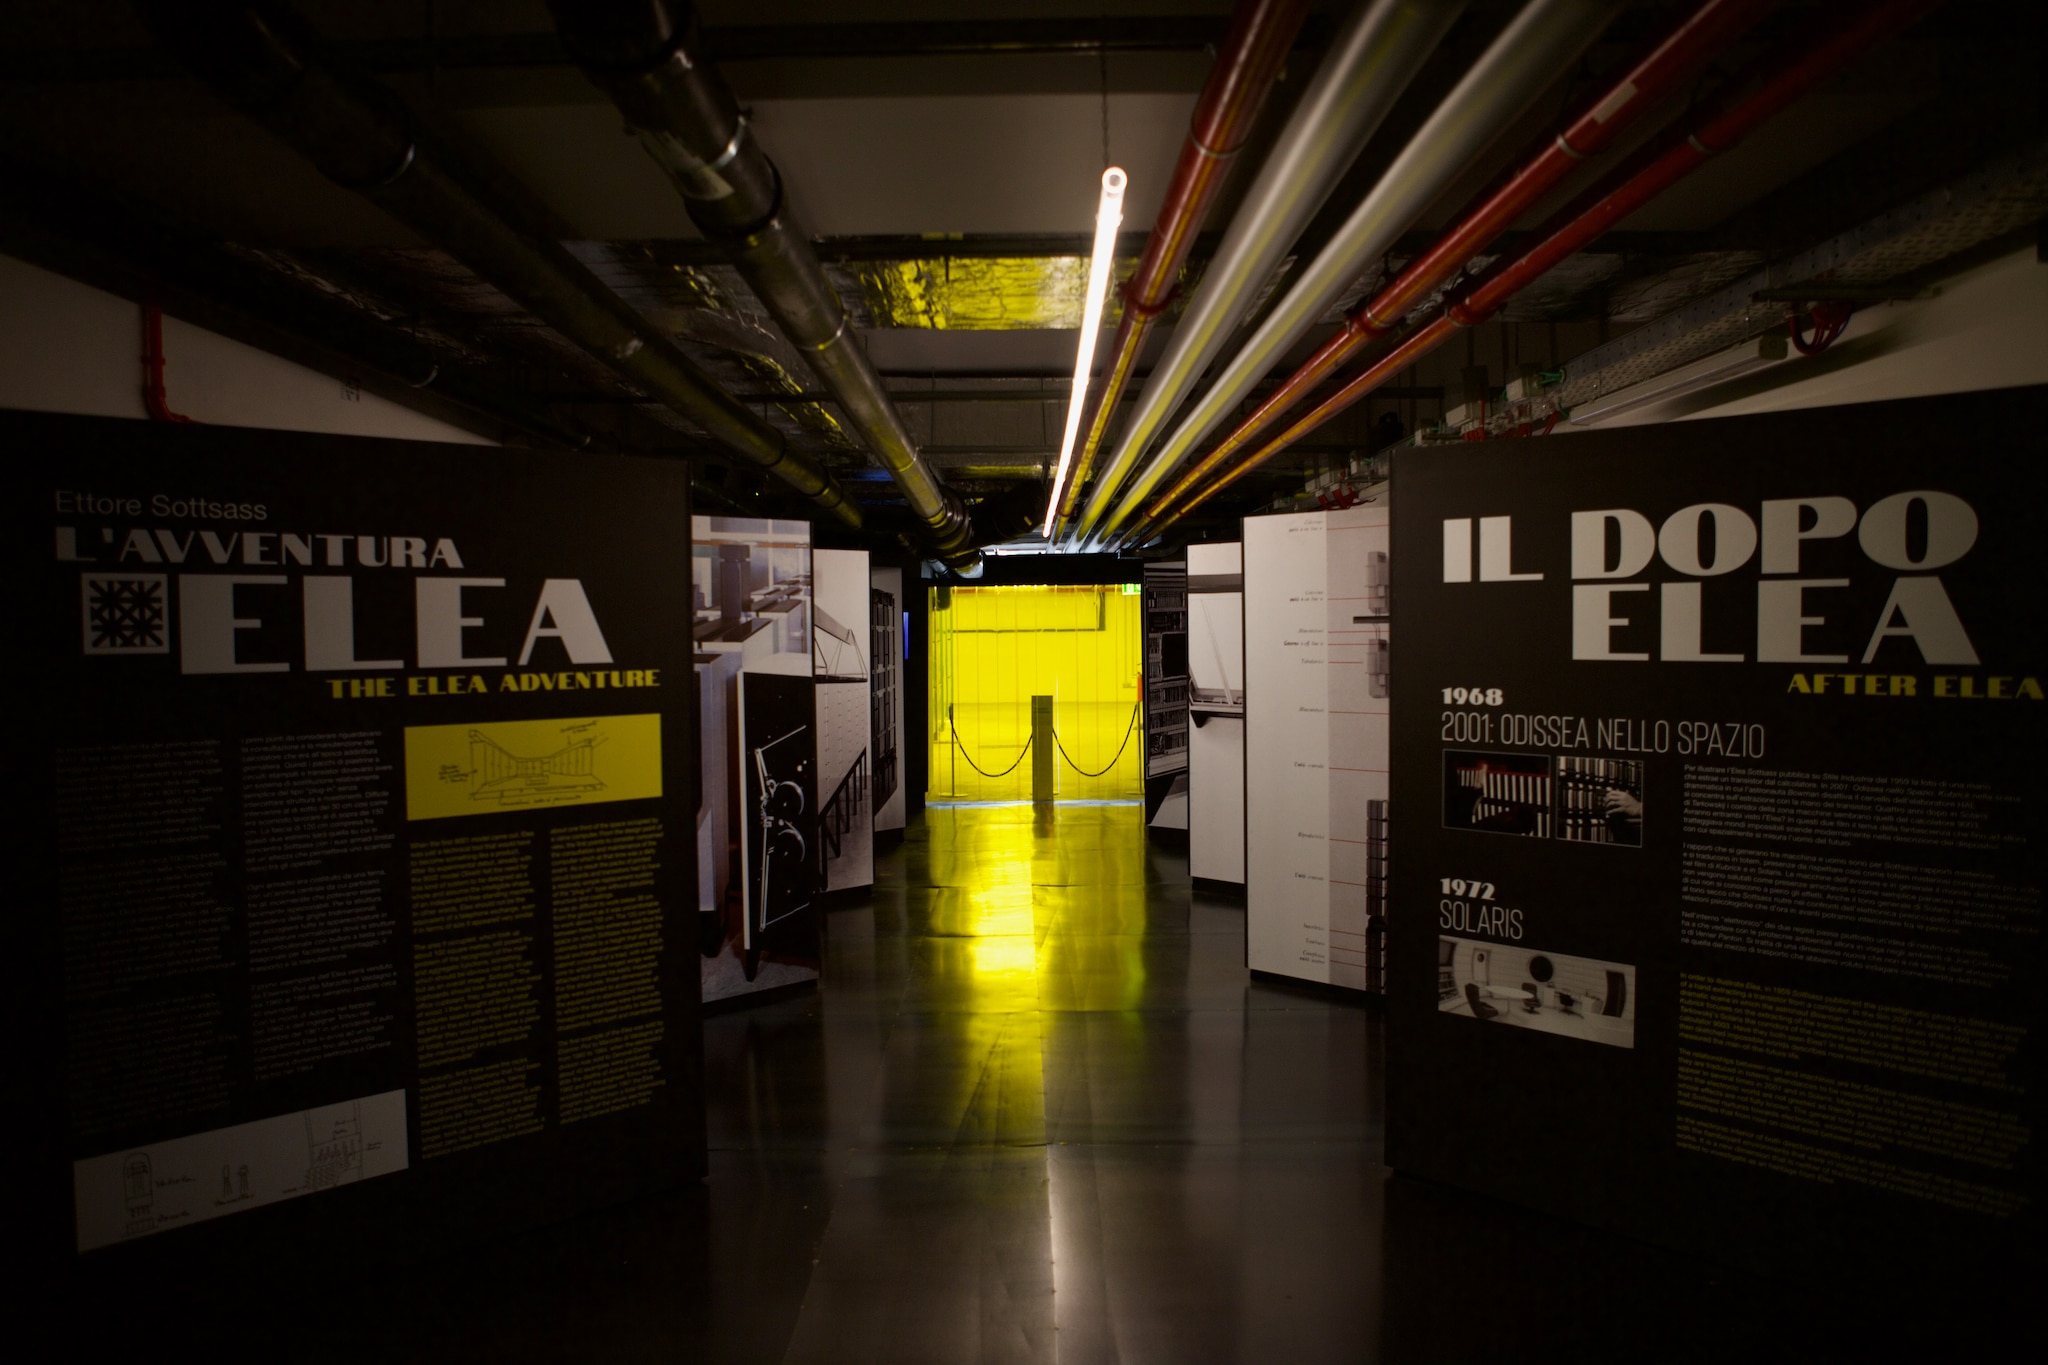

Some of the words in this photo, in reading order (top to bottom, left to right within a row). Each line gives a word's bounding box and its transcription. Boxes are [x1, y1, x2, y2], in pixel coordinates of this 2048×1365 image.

[54, 490, 142, 517] Ettore
[152, 494, 268, 521] Sottsass
[55, 526, 465, 569] L'AVVENTURA
[1443, 515, 1544, 583] IL
[1571, 490, 1979, 580] DOPO
[178, 573, 614, 675] ELEA
[1572, 576, 1981, 665] ELEA
[327, 677, 395, 699] THE
[407, 675, 488, 697] ELEA
[499, 668, 661, 693] ADVENTURE
[1441, 687, 1504, 707] 1968
[1787, 673, 1917, 697] AFTER
[1933, 675, 2045, 700] ELEA
[1441, 711, 1494, 743] 2001:
[1501, 714, 1590, 749] ODISSEA
[1598, 718, 1670, 754] NELLO
[1678, 721, 1765, 759] SPAZIO
[1440, 877, 1496, 901] 1972
[1439, 898, 1524, 940] SOLARIS
